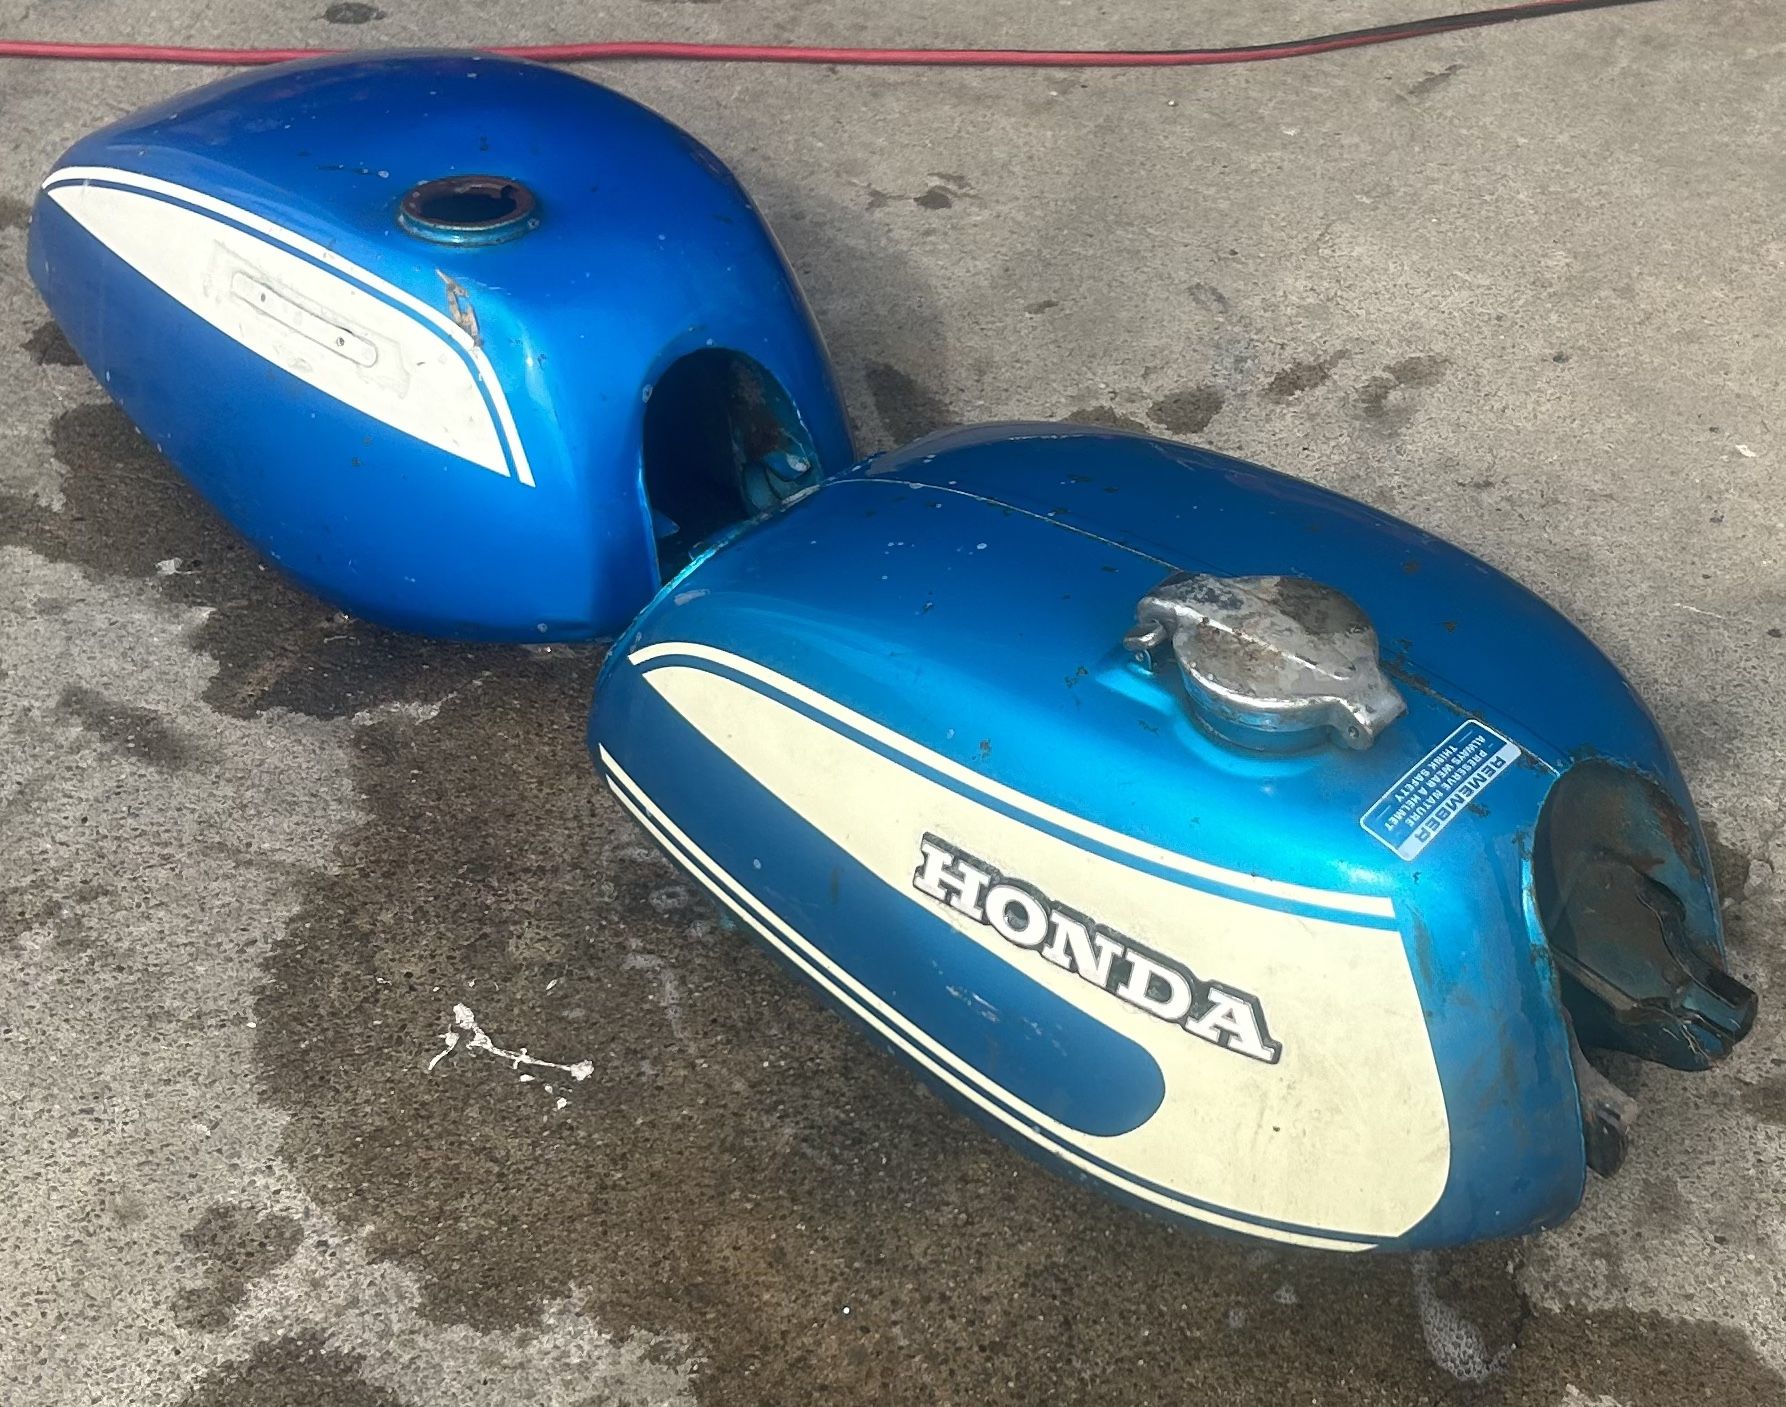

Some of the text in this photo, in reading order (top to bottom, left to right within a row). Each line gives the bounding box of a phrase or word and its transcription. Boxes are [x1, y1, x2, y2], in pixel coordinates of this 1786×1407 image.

[1384, 735, 1486, 832] ALWAYS WEAR A HELMET
[1394, 745, 1458, 803] THINK SAFETY
[1404, 750, 1488, 828] PRESERVE NATURE
[1415, 755, 1506, 843] REMEMBER
[913, 836, 1280, 1063] HONDA
